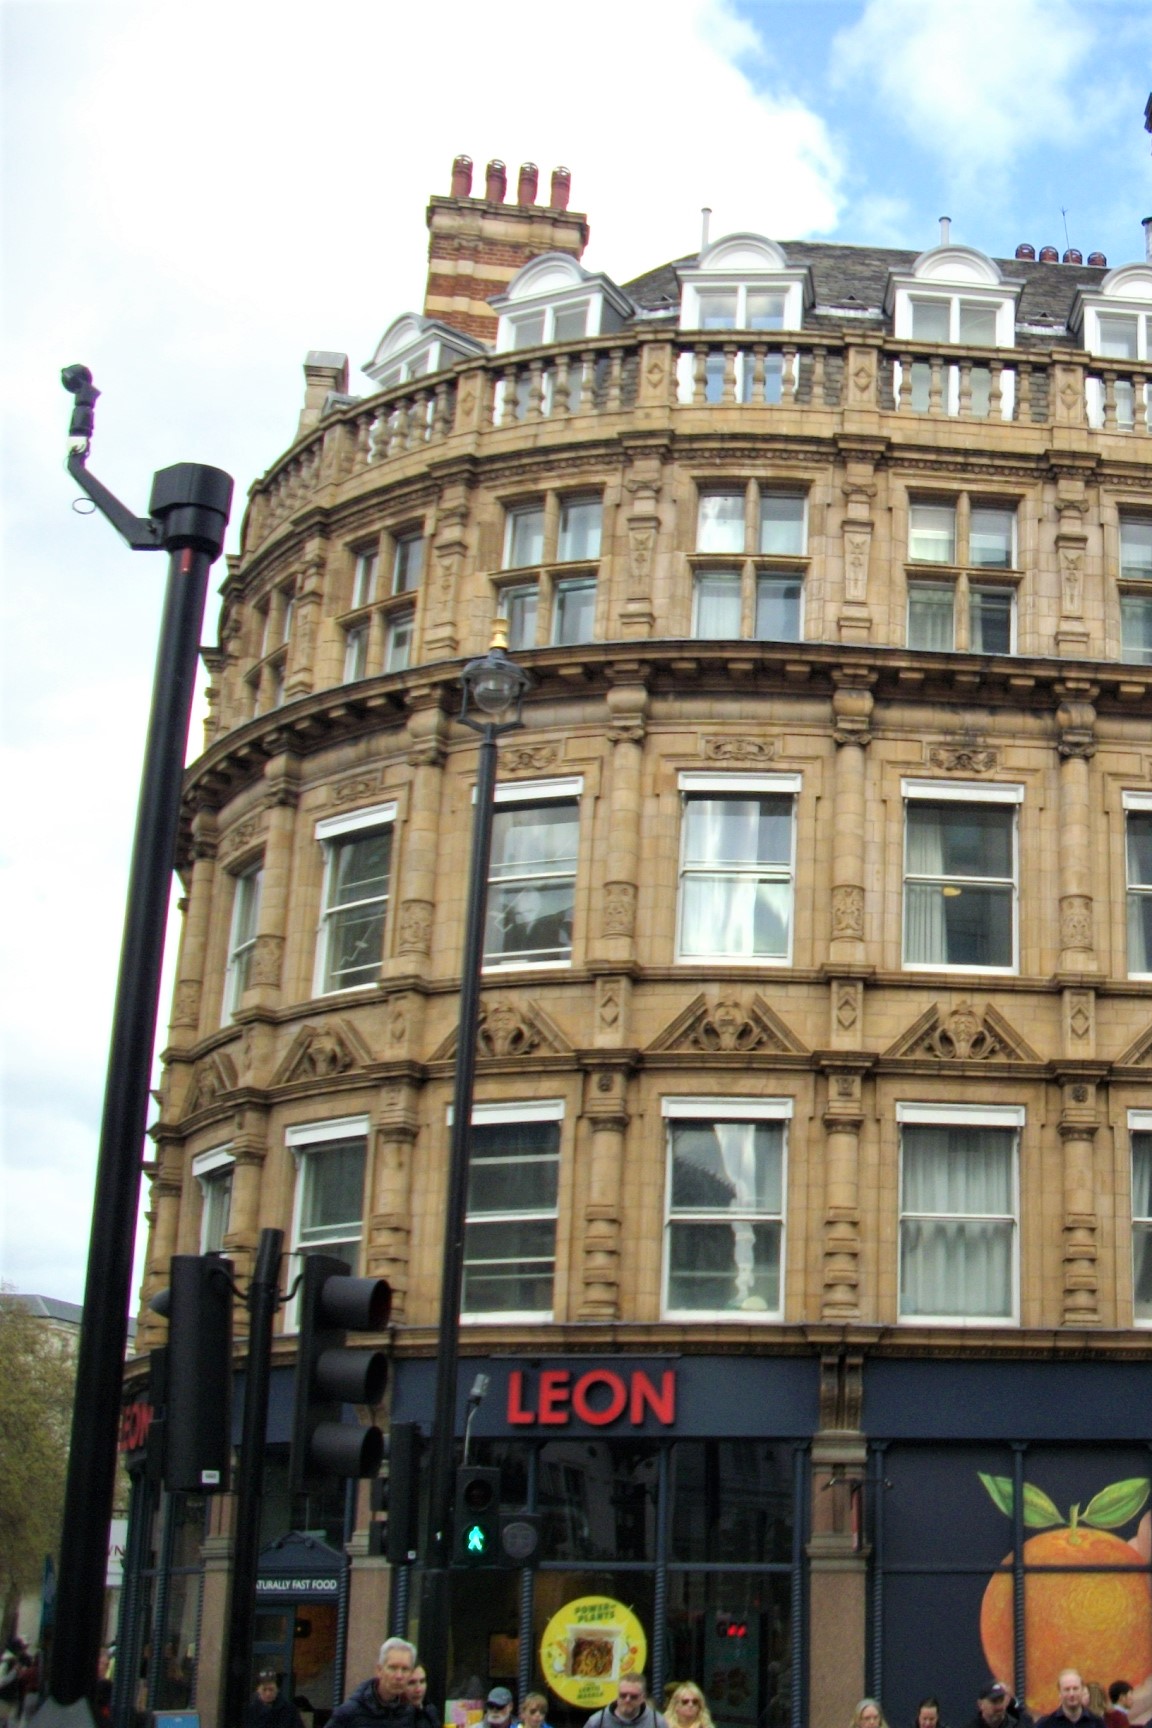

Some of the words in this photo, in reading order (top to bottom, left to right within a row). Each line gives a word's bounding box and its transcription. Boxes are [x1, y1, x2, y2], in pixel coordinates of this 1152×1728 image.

[507, 1368, 676, 1426] LEON
[119, 1402, 154, 1452] EON
[256, 1580, 290, 1590] ATURALLY
[292, 1580, 310, 1590] FAST
[312, 1580, 337, 1590] FOOD
